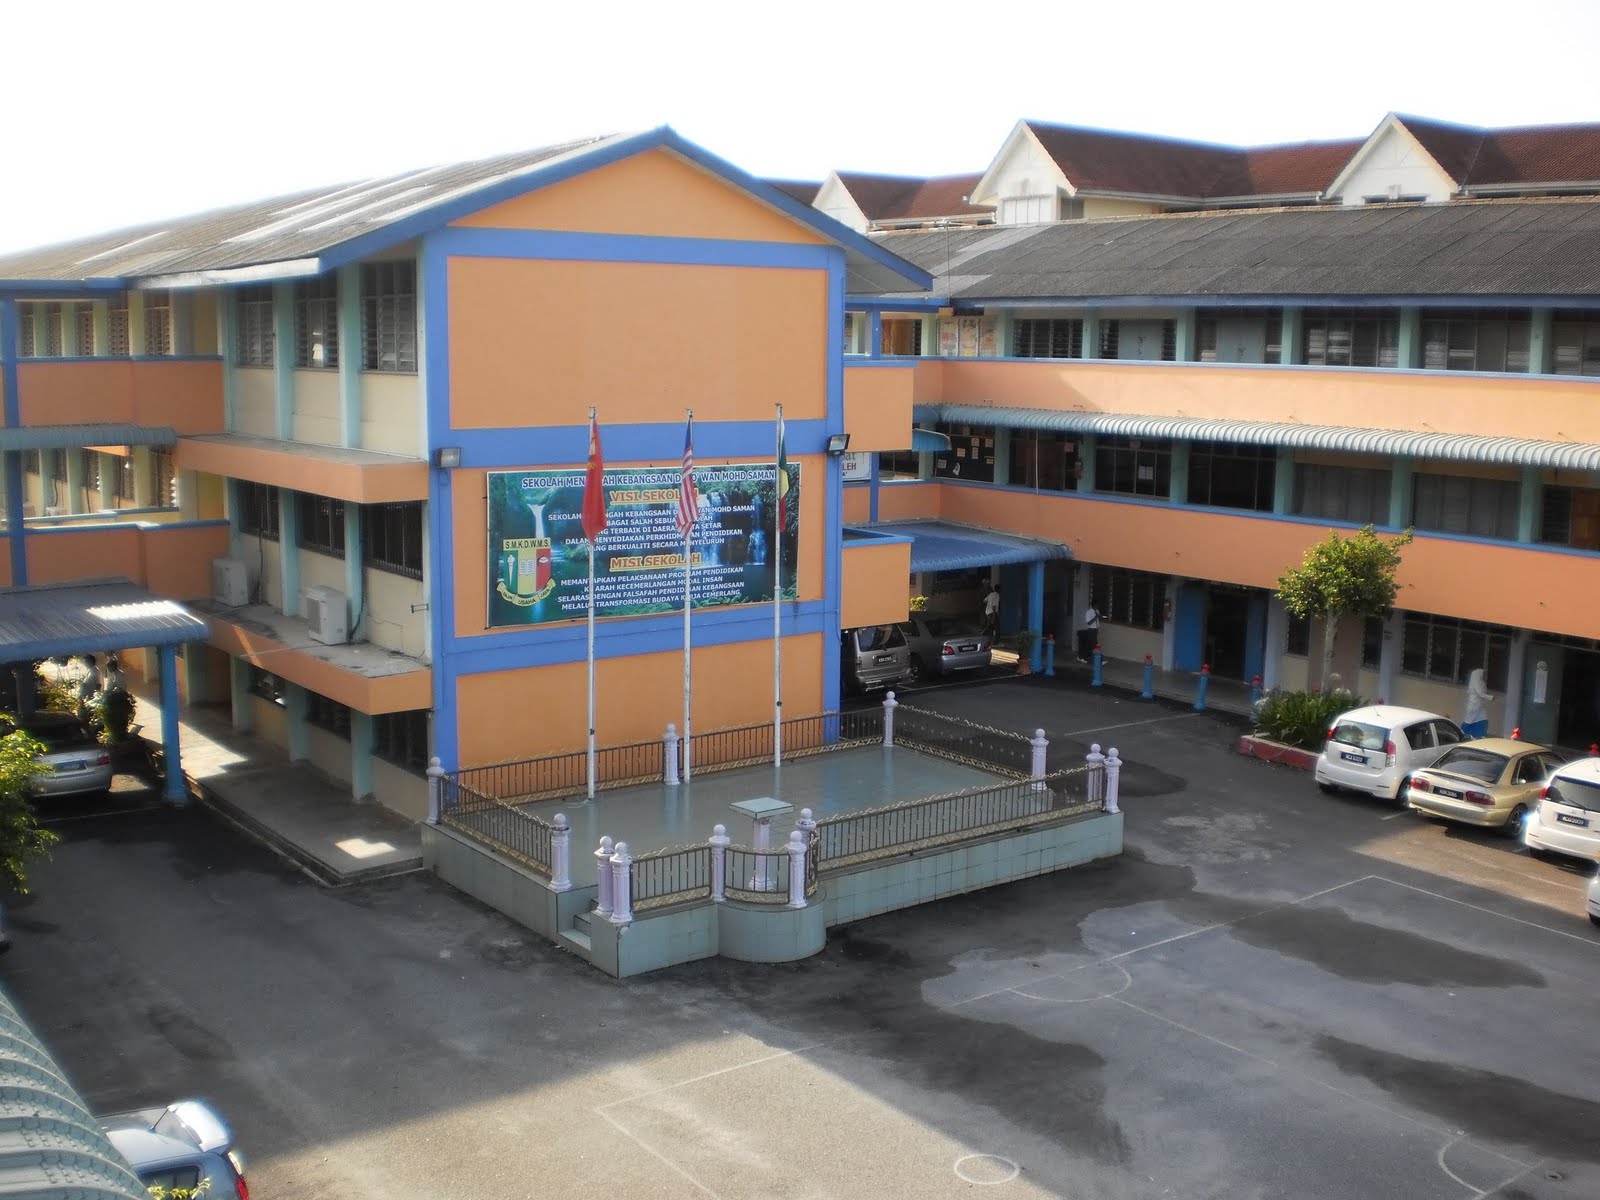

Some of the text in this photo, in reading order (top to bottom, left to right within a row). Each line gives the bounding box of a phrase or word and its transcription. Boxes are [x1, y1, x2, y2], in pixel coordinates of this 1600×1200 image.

[522, 476, 564, 488] SEKOLAH
[565, 474, 616, 487] MENAH
[616, 473, 673, 485] KEBANGSAAN
[701, 471, 721, 482] WAN
[721, 470, 747, 482] MOHD
[747, 470, 775, 481] SAMAN
[610, 490, 640, 502] VISI
[625, 509, 674, 517] KEBANGSAAN
[630, 518, 653, 526] SALAH
[701, 529, 743, 538] PENDIDIKAN
[608, 543, 651, 551] BERKUALITI
[677, 538, 725, 547] MNYELURUH
[611, 552, 702, 569] MISI SEKOLH
[617, 573, 667, 582] PELAKSANAAN
[702, 567, 744, 576] PENDIDIKAN
[557, 594, 589, 603] SELARAS
[623, 590, 658, 598] FALSAFAH
[702, 581, 745, 591] KEBANGSAAN
[595, 585, 615, 593] ARAH
[616, 580, 676, 590] KECEMERLANGAN
[595, 597, 651, 608] TRANSFORMASI
[652, 595, 680, 603] BUDAYA
[702, 589, 741, 599] CEMERLANG
